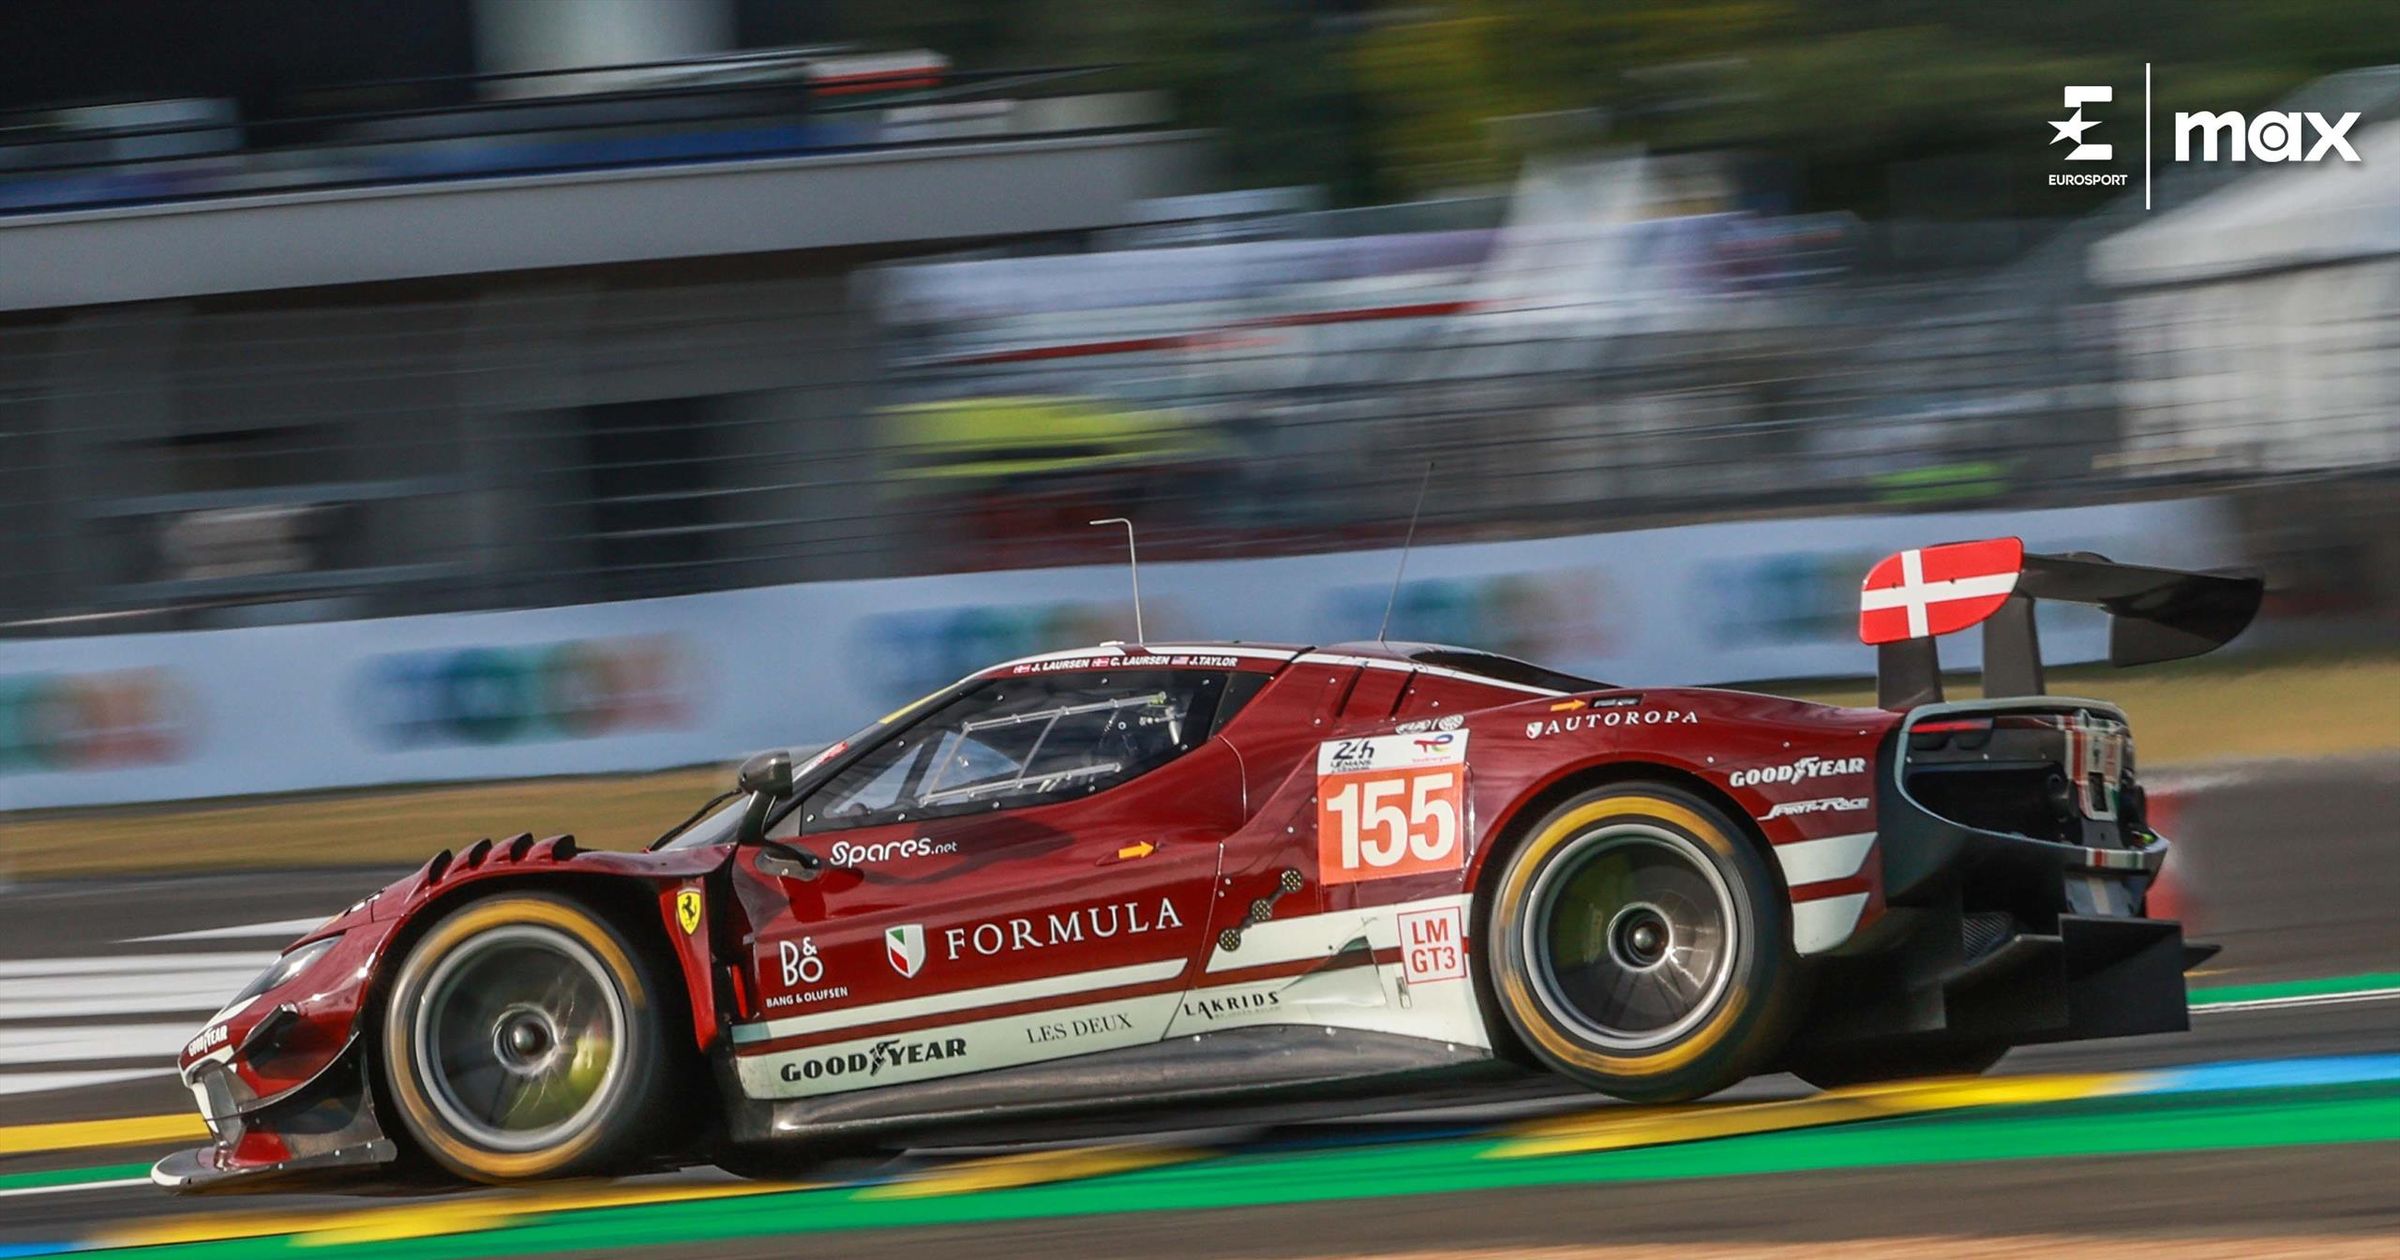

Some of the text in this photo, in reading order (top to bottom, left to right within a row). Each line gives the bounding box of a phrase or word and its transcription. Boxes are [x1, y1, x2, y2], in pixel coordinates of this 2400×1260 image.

[1031, 659, 1090, 672] J. LAURSEN
[1122, 656, 1170, 667] LAURSEN
[1546, 710, 1698, 735] AUTOROPA
[1730, 756, 1866, 787] GOODYEAR
[1326, 772, 1456, 869] 155
[945, 897, 1183, 960] FORMULA
[1411, 918, 1448, 945] LM
[1411, 946, 1456, 973] GT3
[766, 986, 848, 1008] BANG & OLUFSEN
[1184, 991, 1279, 1020] LAKRIDS
[1026, 1013, 1133, 1044] LES DEUX
[780, 1038, 967, 1082] GOODYEAR
